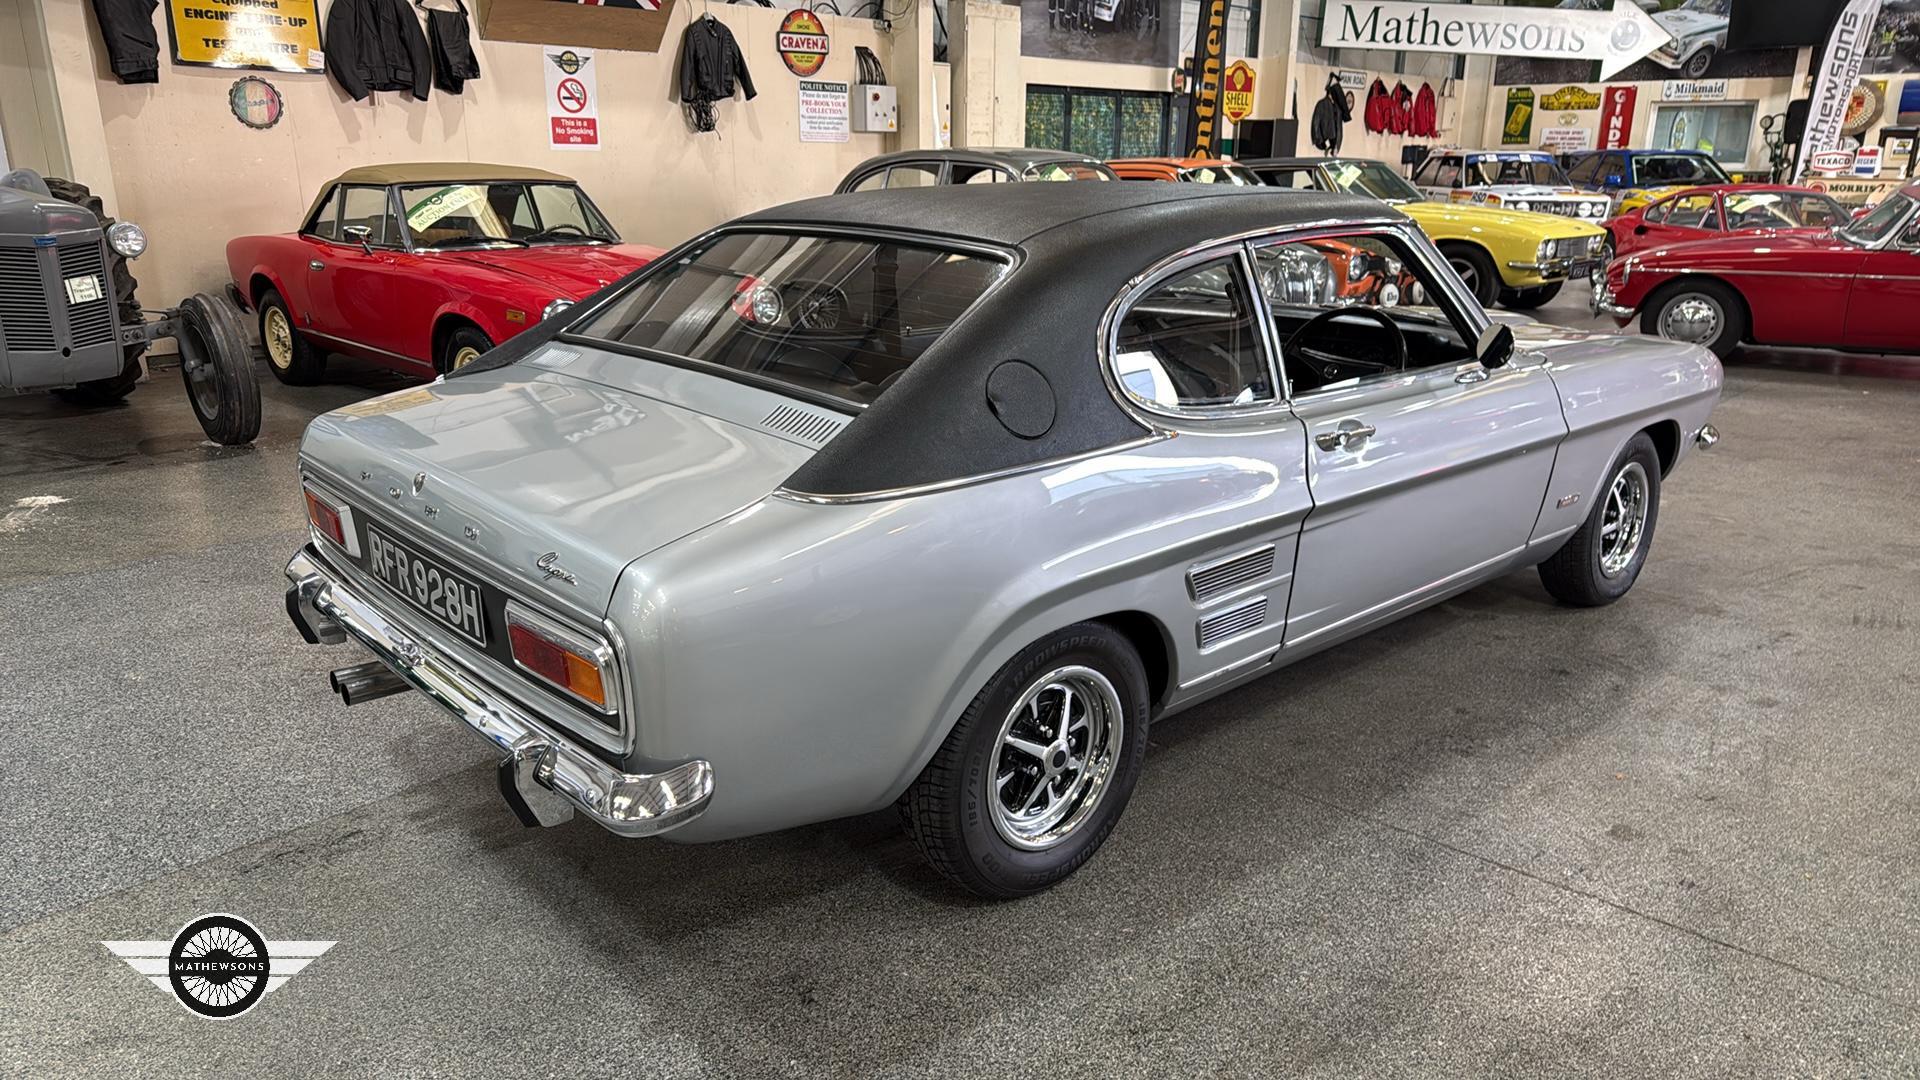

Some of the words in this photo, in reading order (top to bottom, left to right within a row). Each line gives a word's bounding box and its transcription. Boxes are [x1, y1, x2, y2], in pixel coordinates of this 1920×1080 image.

[184, 8, 238, 22] ENGINE
[1337, 3, 1587, 53] Mathewsons
[781, 35, 819, 50] CRAVEN
[801, 82, 823, 90] POLITE
[824, 83, 846, 92] NOTICE
[1674, 82, 1725, 94] Milkmaid
[1225, 92, 1249, 107] SHELL
[566, 128, 594, 136] Smoking
[570, 135, 582, 143] site
[1816, 157, 1851, 165] TEXACO
[1829, 183, 1876, 193] MORRIS
